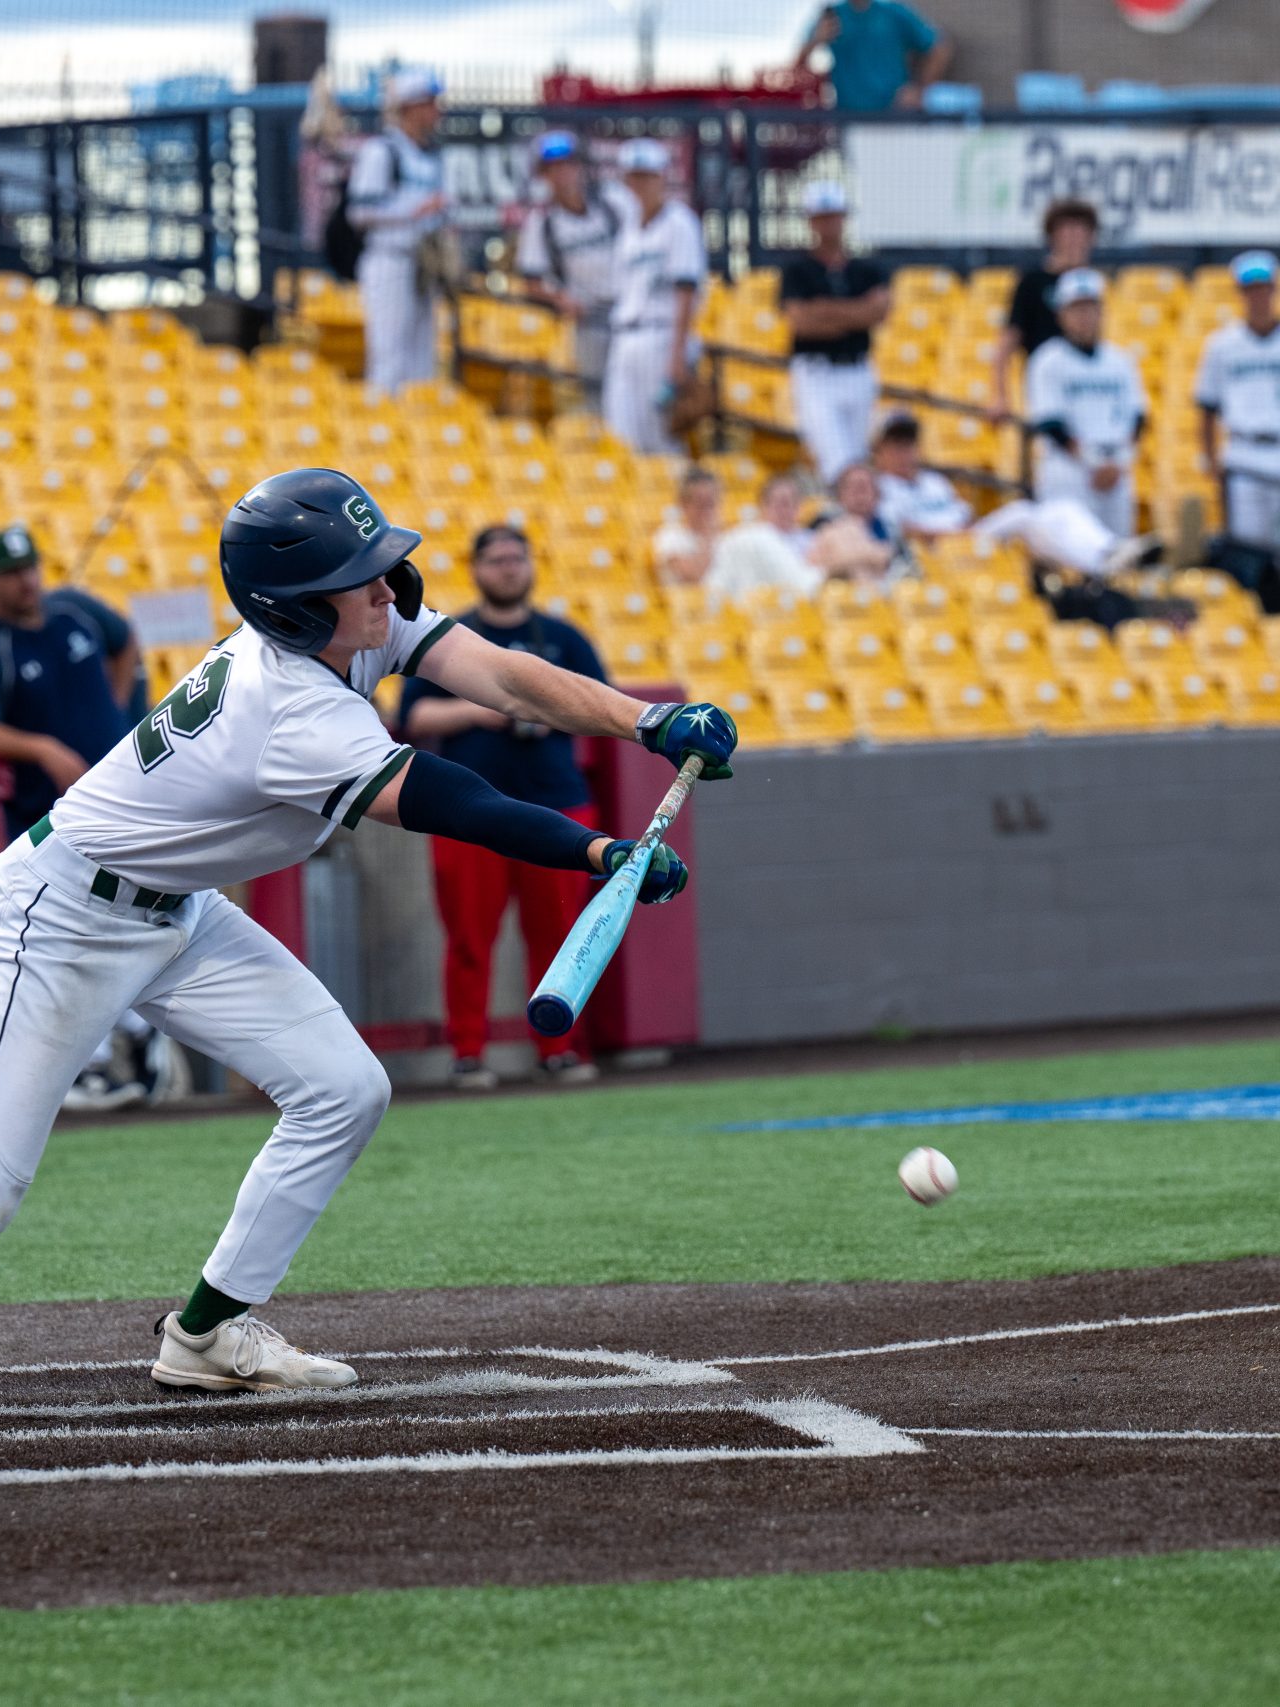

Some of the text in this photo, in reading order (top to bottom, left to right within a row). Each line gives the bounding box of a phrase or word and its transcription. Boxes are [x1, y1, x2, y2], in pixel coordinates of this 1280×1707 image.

[342, 496, 380, 541] S
[250, 592, 276, 606] ELITE
[133, 634, 236, 775] 2
